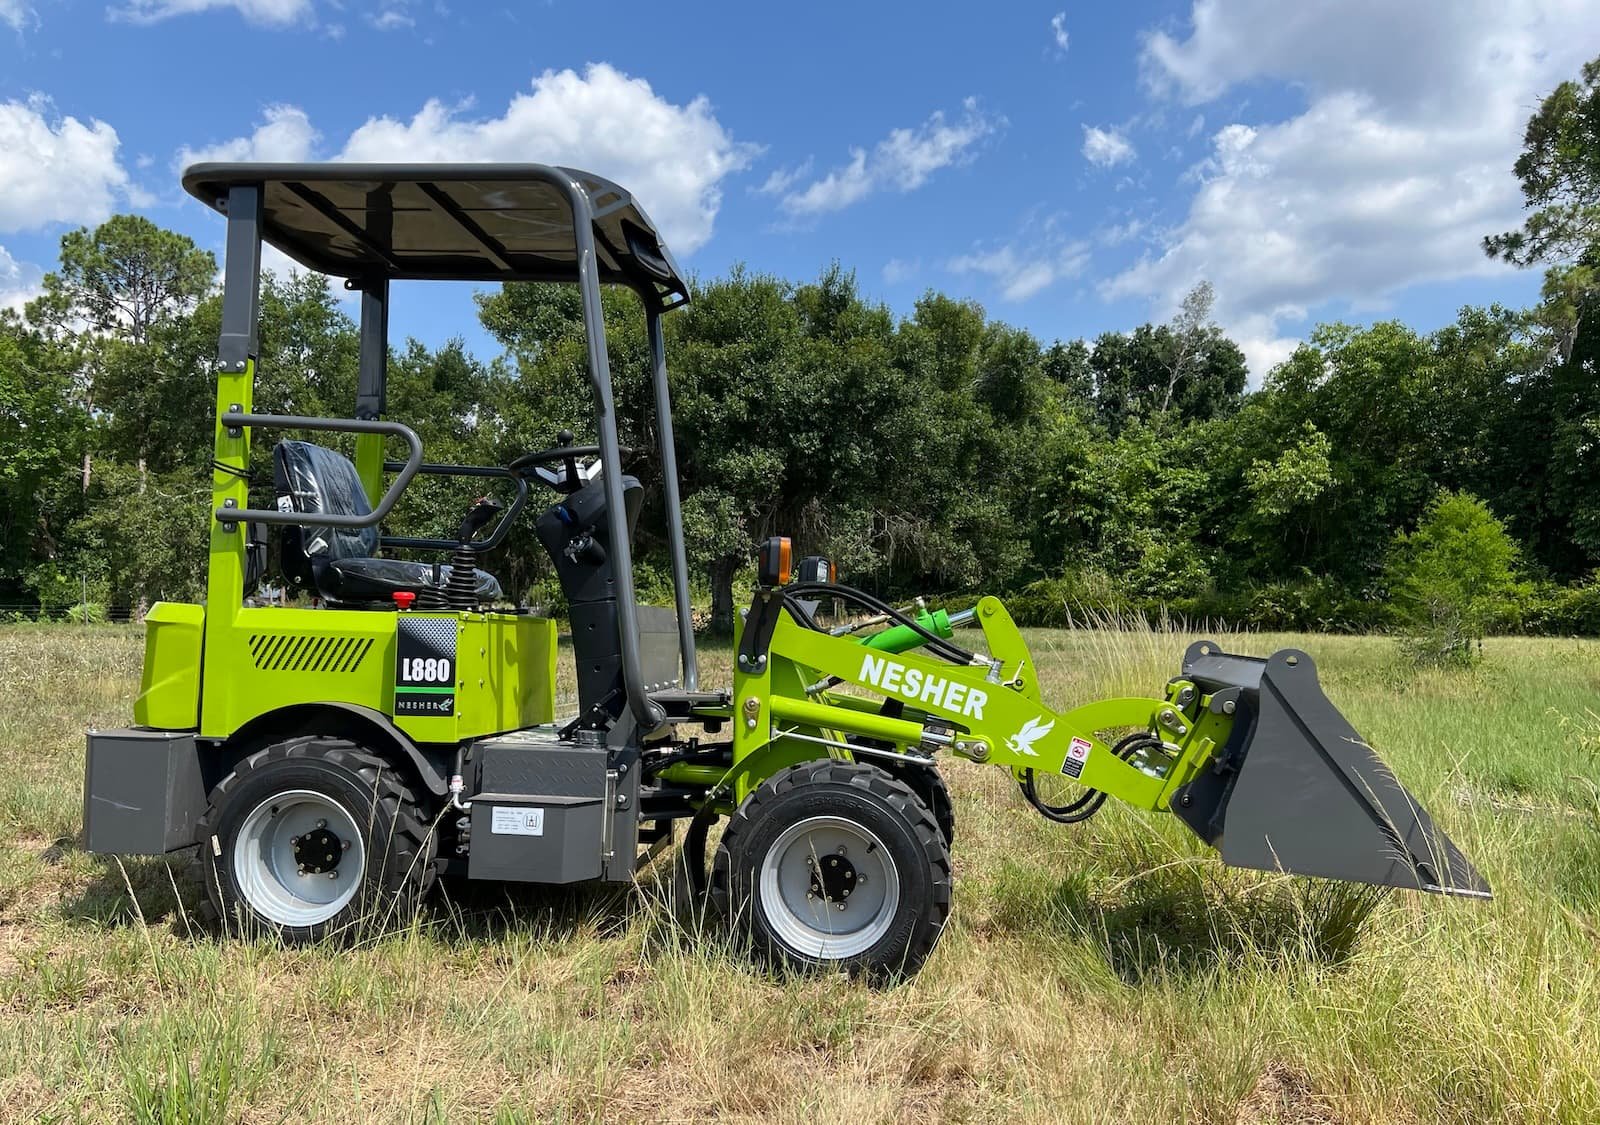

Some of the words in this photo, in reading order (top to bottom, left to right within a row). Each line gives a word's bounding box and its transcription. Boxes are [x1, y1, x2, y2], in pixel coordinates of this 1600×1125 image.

[402, 658, 450, 682] L880
[858, 654, 988, 720] NESHER
[398, 701, 438, 710] NESHER
